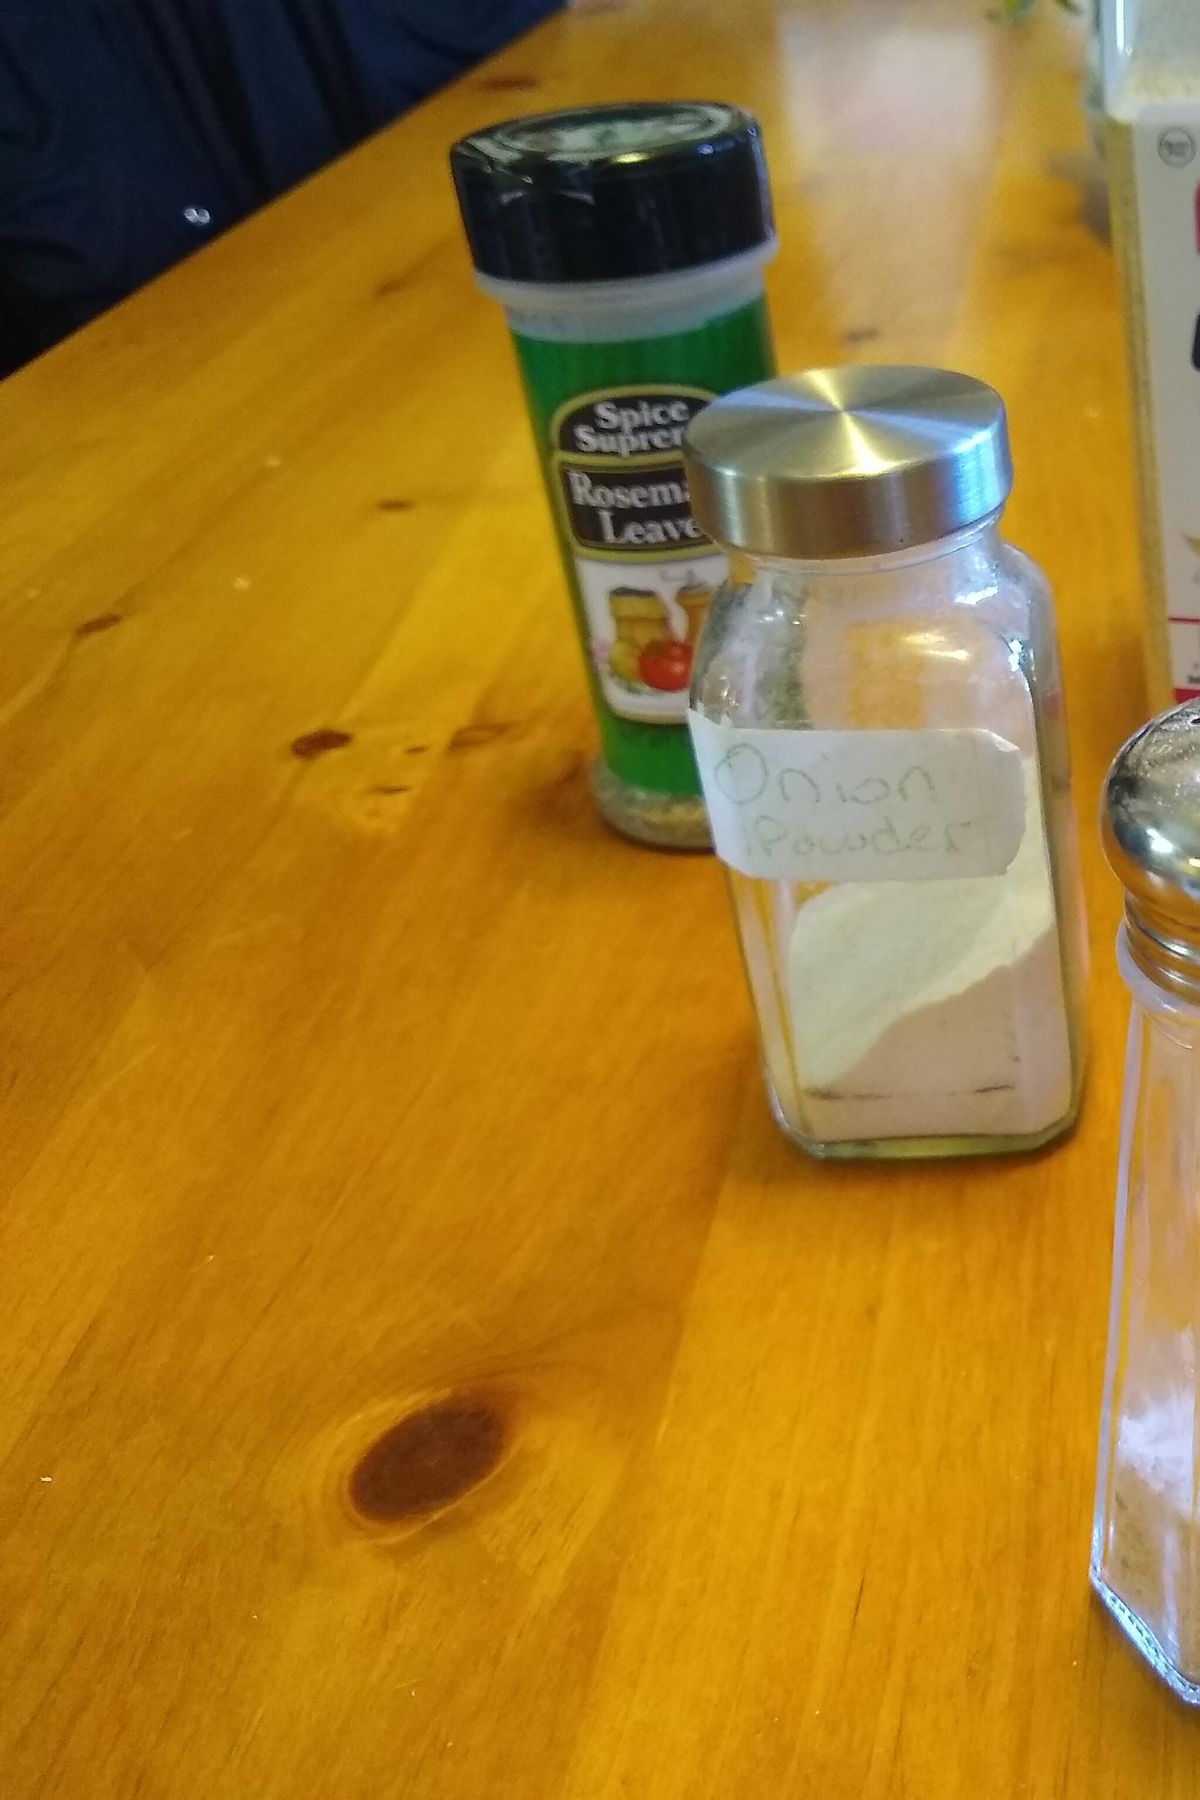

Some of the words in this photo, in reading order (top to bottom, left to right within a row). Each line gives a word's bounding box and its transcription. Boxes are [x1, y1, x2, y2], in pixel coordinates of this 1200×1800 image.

[593, 400, 690, 434] Spice
[567, 469, 690, 509] Rosem
[714, 742, 936, 804] Onion
[754, 814, 971, 856] Powder
